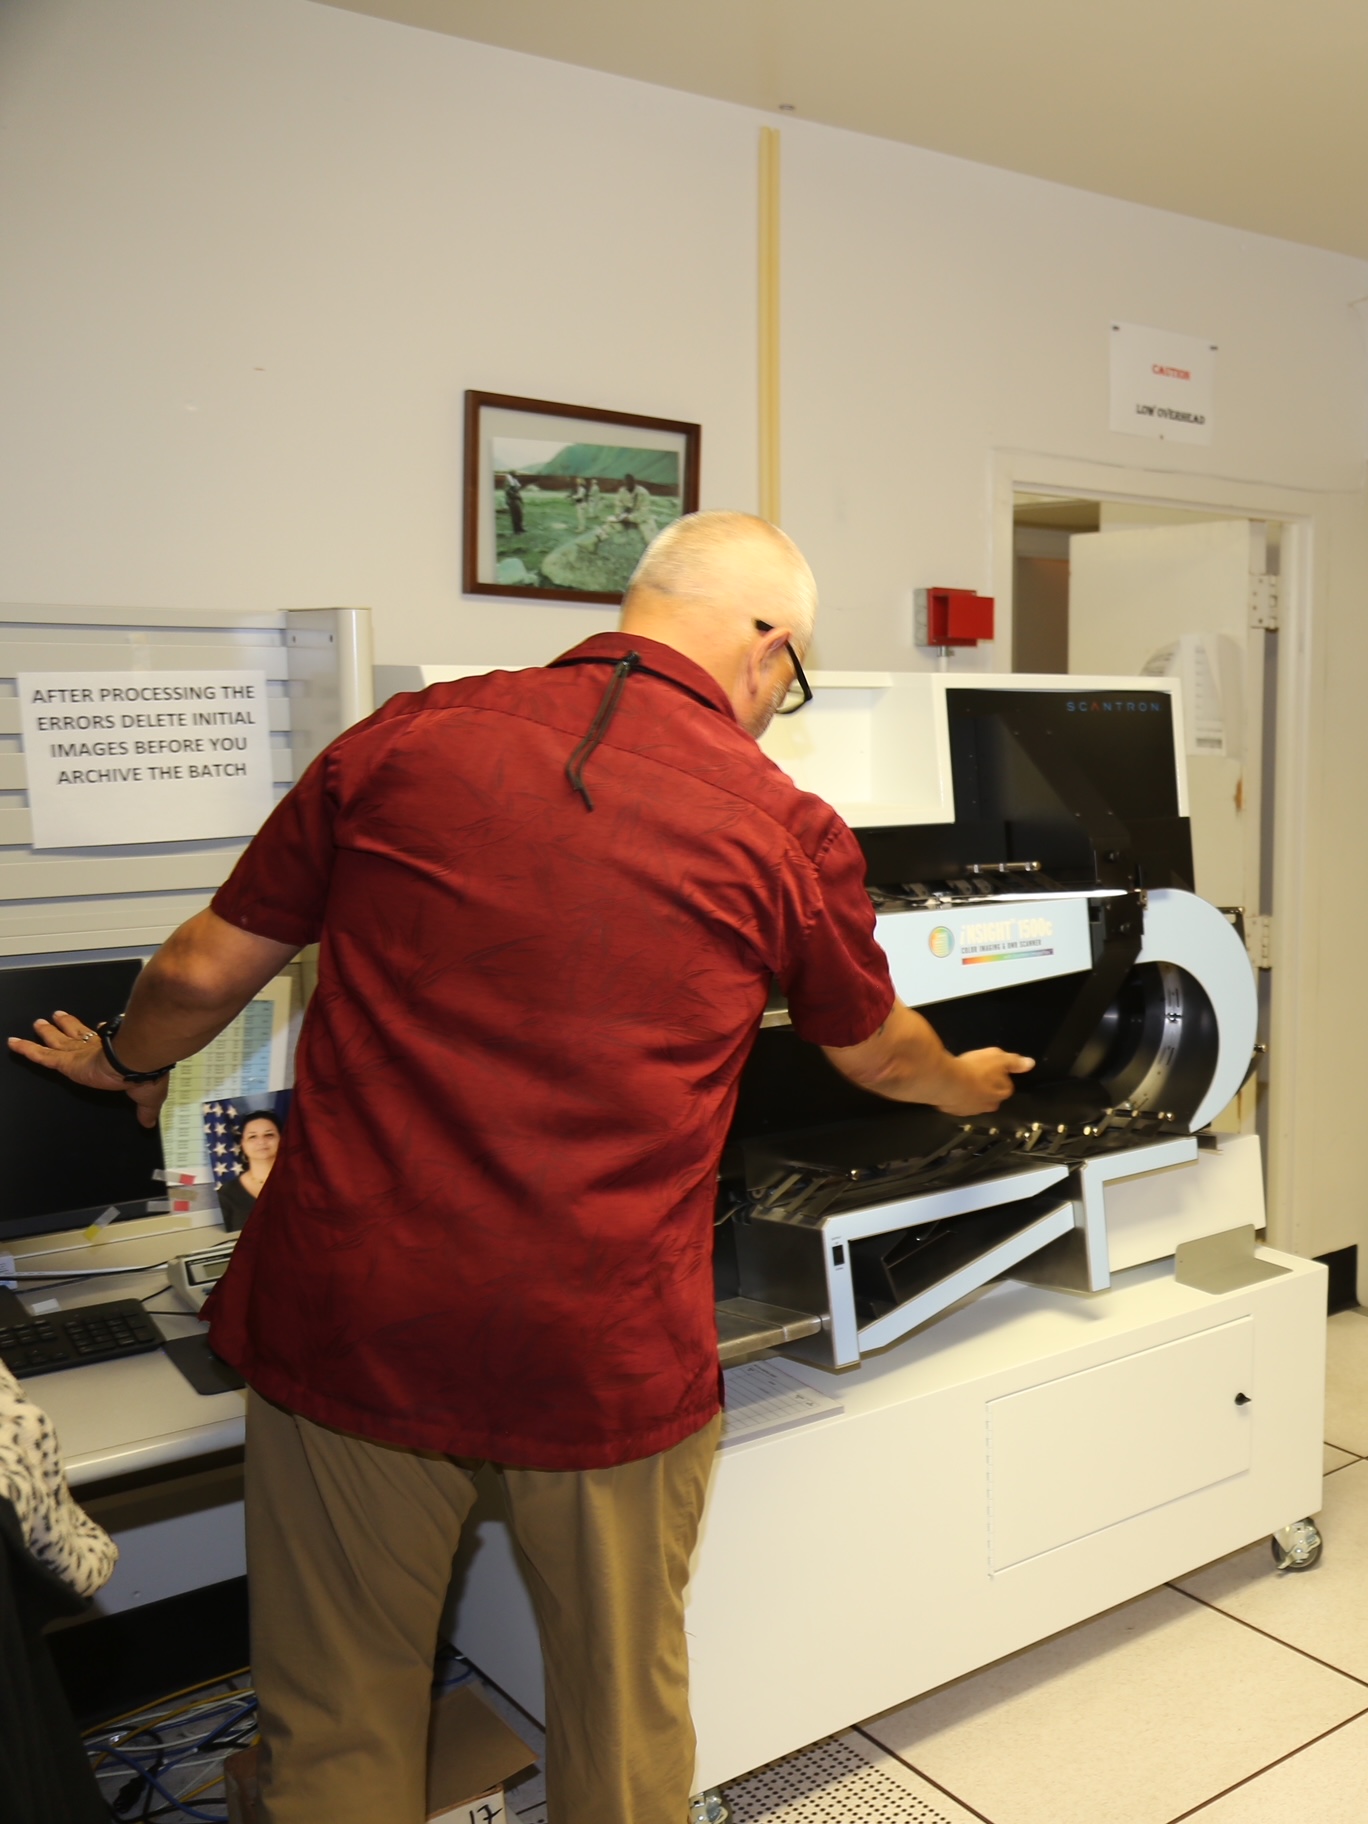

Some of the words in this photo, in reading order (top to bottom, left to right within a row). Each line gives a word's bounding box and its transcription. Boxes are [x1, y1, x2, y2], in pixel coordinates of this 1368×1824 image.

[1136, 404, 1156, 417] LOW
[1157, 407, 1206, 425] OVERHEAD
[32, 688, 95, 704] AFTER
[100, 686, 217, 703] PROCESSING
[221, 685, 256, 700] THE
[1066, 701, 1161, 713] SCANTRON
[37, 714, 116, 731] ERRORS
[121, 712, 188, 729] DELETE
[192, 710, 256, 727] INITIAL
[50, 742, 129, 758] IMAGES
[135, 739, 206, 755] BEFORE
[210, 737, 248, 752] YOU
[57, 768, 143, 785] ARCHIVE
[149, 765, 183, 781] THE
[189, 763, 247, 779] BATCH
